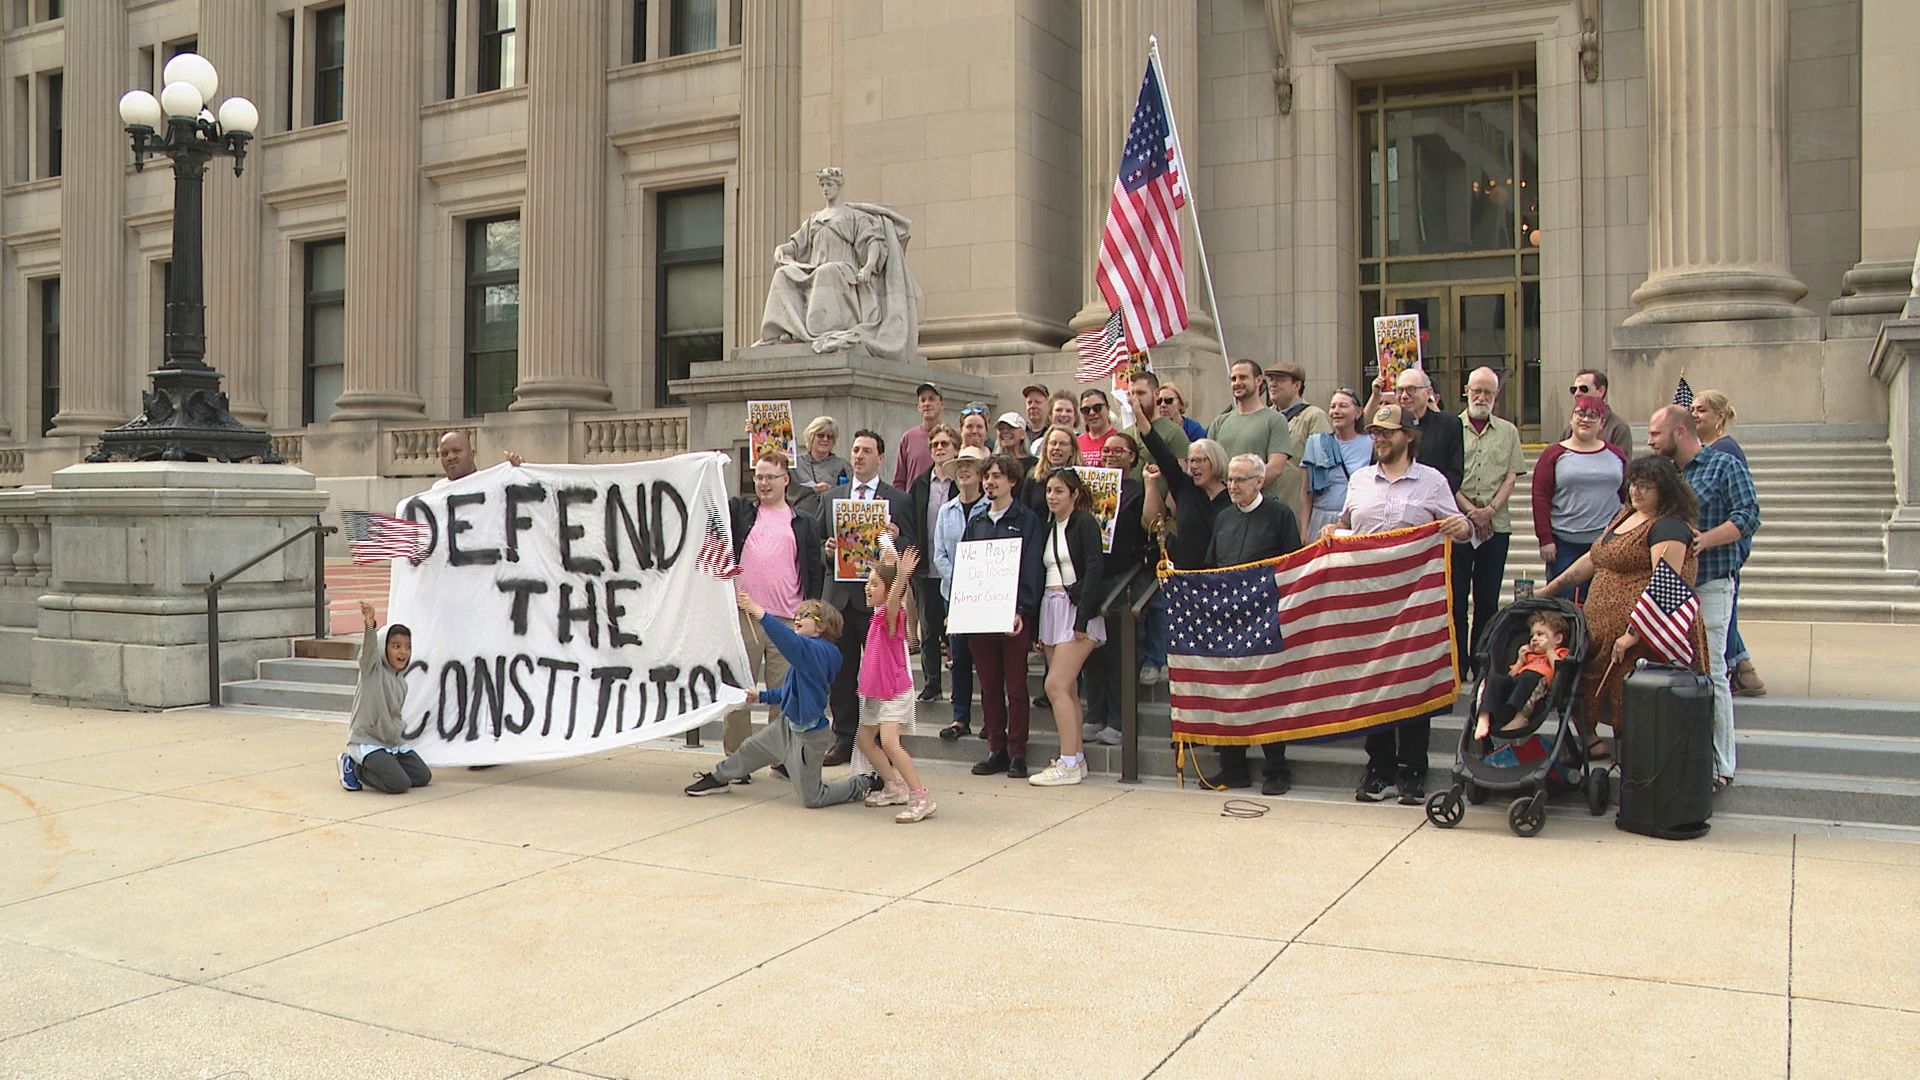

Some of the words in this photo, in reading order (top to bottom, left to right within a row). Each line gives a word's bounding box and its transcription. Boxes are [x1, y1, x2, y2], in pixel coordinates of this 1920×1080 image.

[1376, 319, 1415, 330] SOLIDARITY
[1377, 328, 1416, 341] FOREVER
[750, 403, 788, 412] SOLIDARITY
[751, 411, 790, 422] FOREVER
[1079, 471, 1119, 481] OLIDARITY
[836, 503, 886, 513] SOLIDARITY
[836, 513, 886, 526] FOREVER
[403, 480, 689, 576] DEFEND
[960, 543, 977, 560] We
[498, 579, 642, 650] THE
